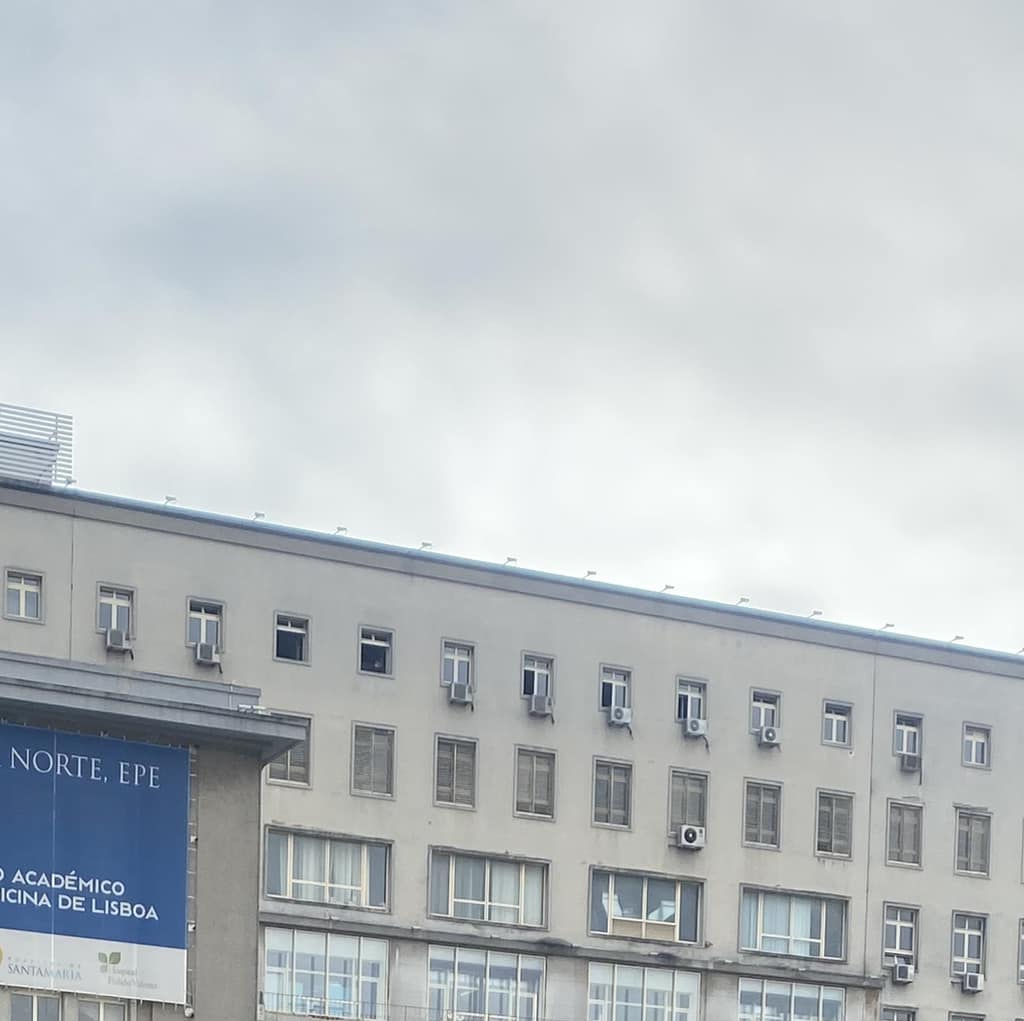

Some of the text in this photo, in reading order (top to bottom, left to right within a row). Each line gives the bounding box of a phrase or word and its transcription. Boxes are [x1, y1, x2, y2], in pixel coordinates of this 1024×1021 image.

[10, 747, 109, 785] NORTE,
[119, 762, 162, 790] EPE
[11, 869, 126, 897] ACADÉMICO
[58, 895, 85, 912] DE
[91, 898, 160, 921] LISBOA
